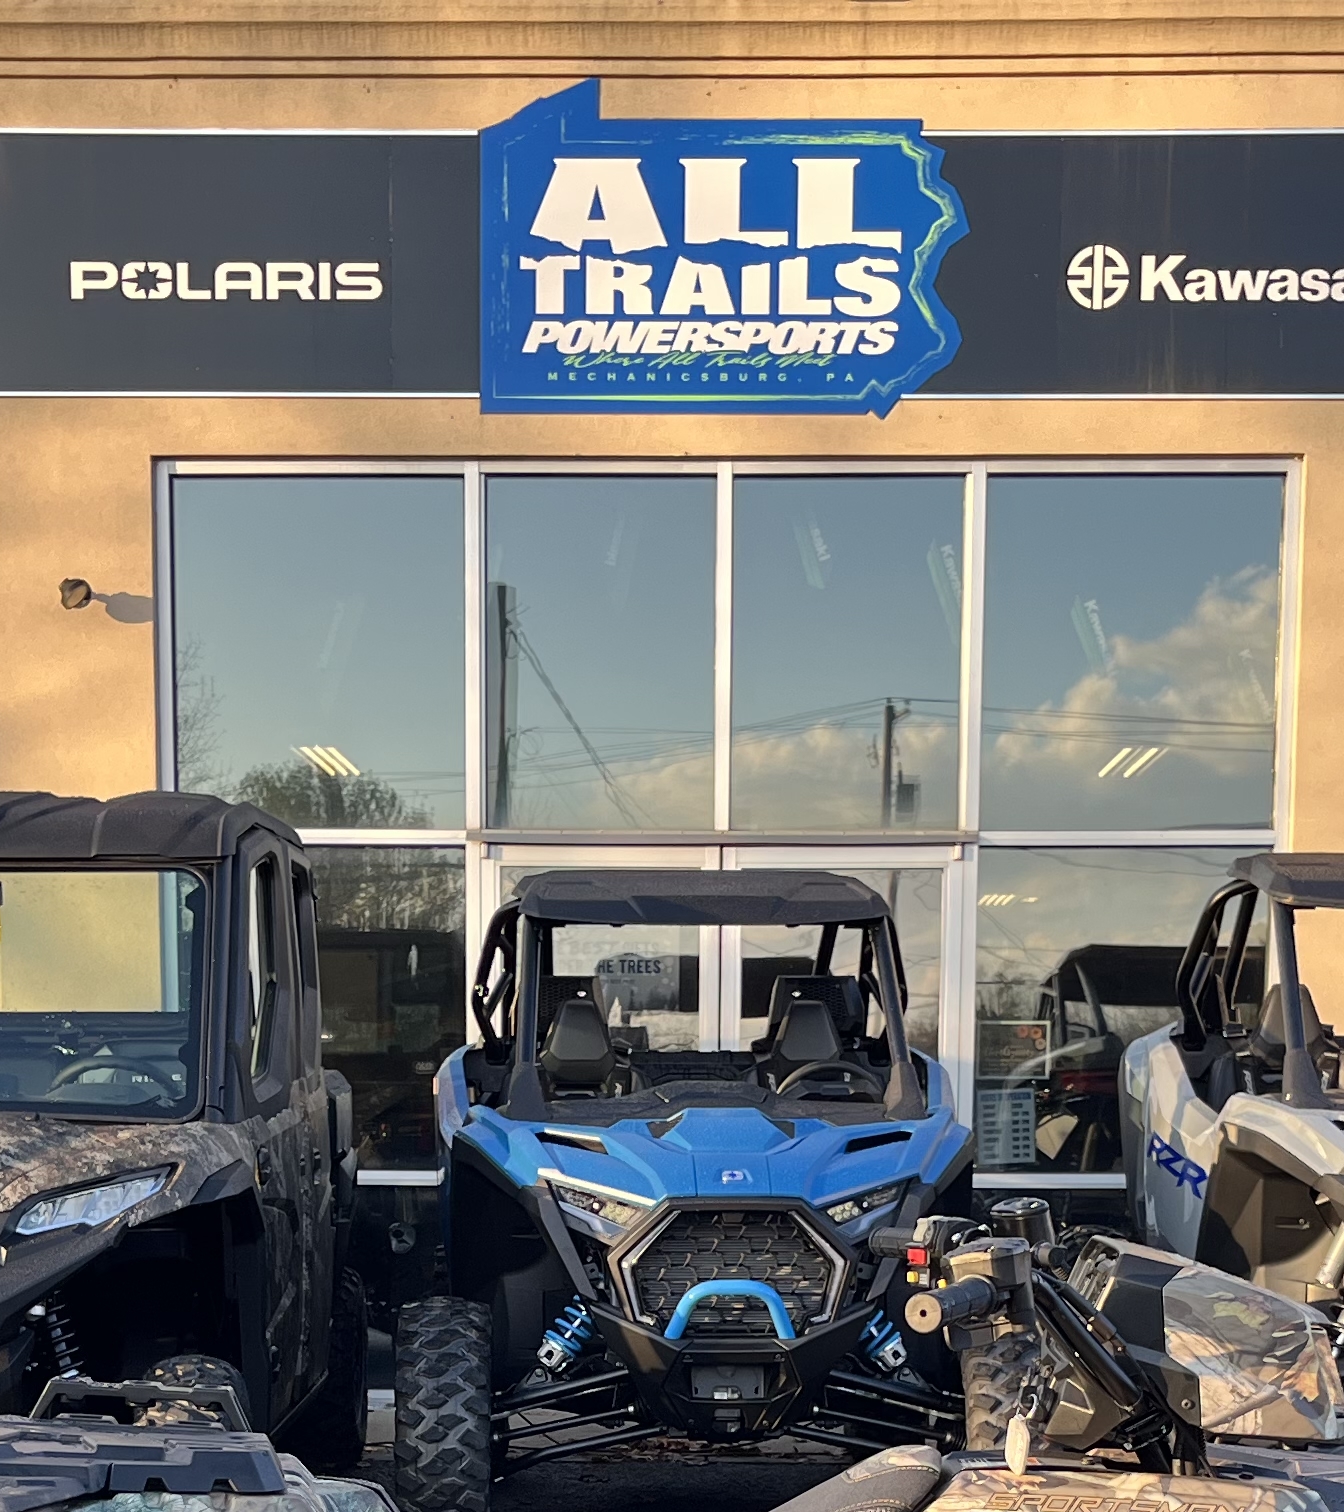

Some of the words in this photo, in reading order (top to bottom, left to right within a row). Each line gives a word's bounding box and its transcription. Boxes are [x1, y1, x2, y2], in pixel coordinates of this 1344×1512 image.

[530, 157, 902, 254] ALL
[69, 261, 384, 300] POLARIS
[519, 255, 902, 317] TRAILS
[521, 320, 900, 355] POWERSPORTS
[563, 351, 644, 369] Where
[647, 350, 703, 370] All
[704, 349, 774, 369] Trails
[774, 351, 838, 369] Meet
[826, 372, 854, 382] PA
[619, 959, 661, 974] TREES
[1147, 1130, 1208, 1199] RZR
